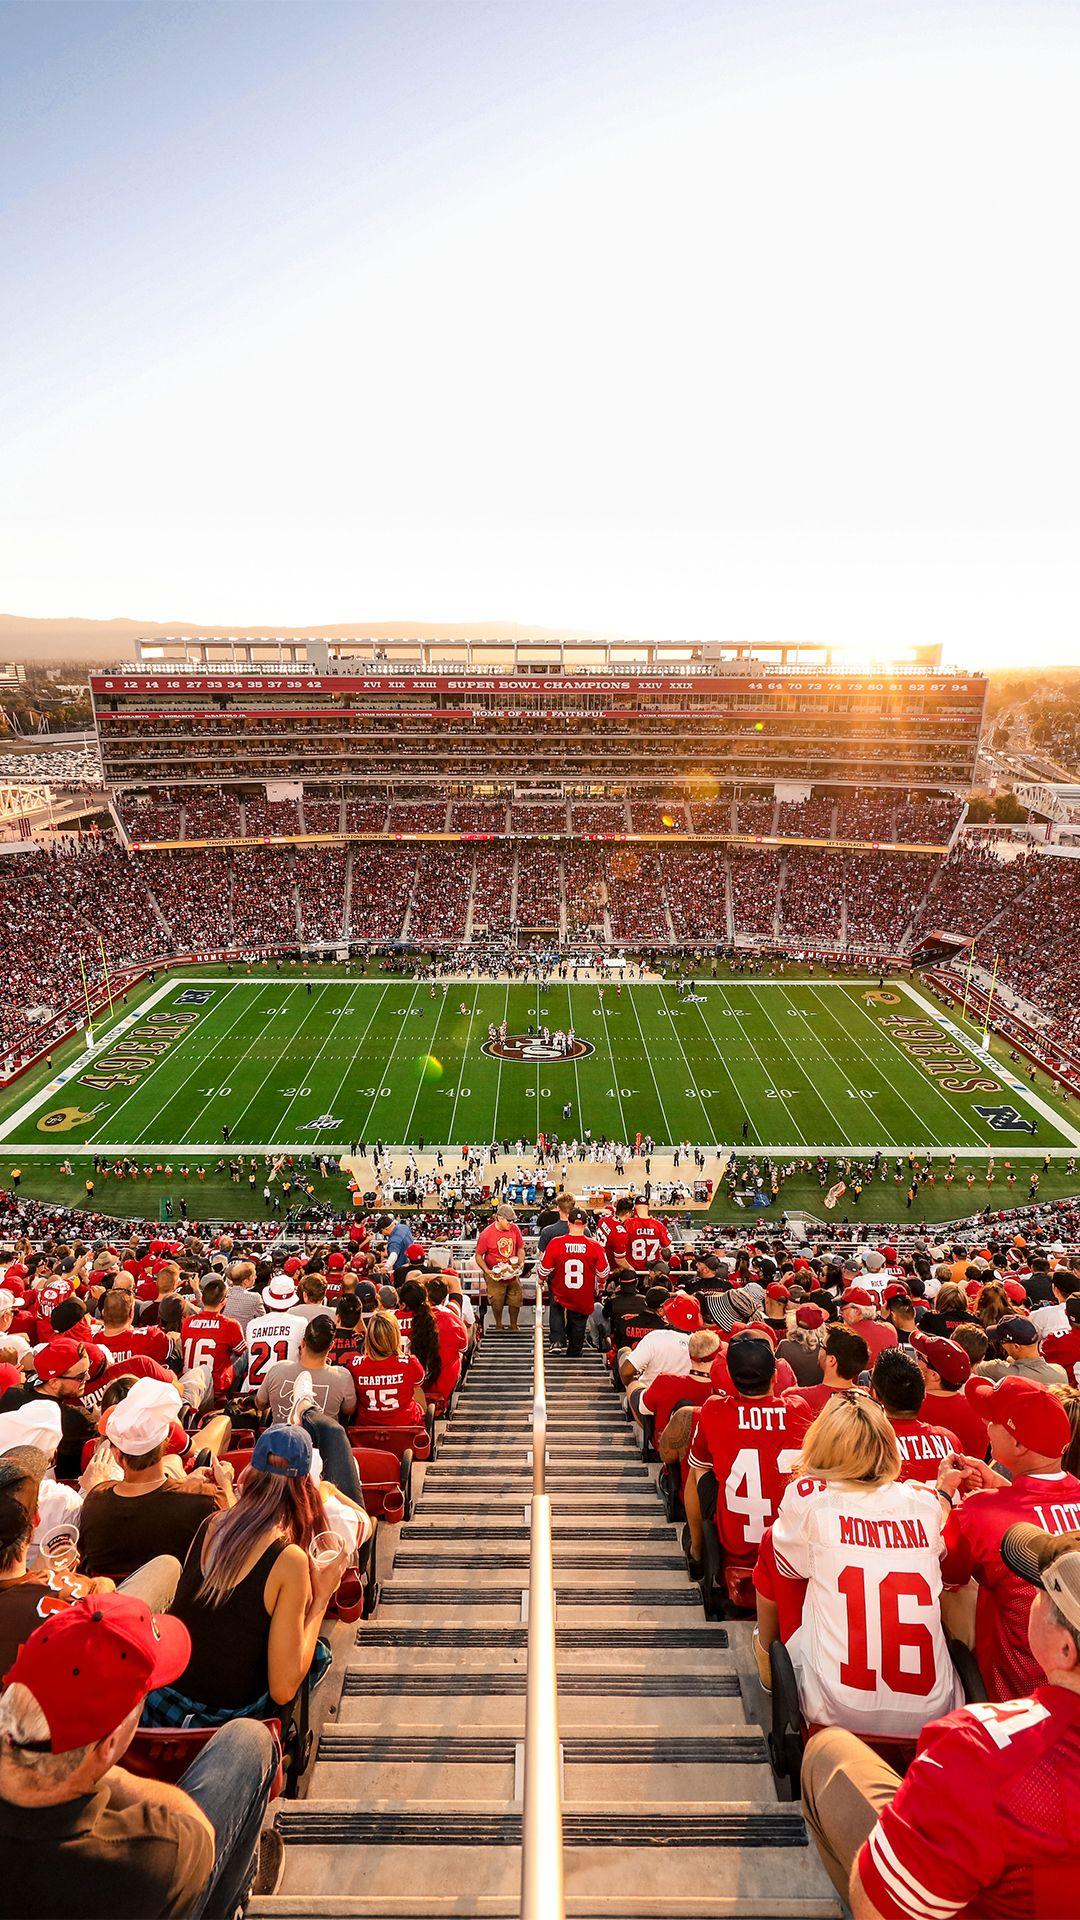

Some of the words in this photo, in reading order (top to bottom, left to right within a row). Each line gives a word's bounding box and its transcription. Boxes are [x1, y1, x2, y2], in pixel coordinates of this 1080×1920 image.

[448, 681, 495, 689] SUPER
[499, 681, 540, 689] BOWL
[197, 953, 223, 962] HOME
[76, 1012, 200, 1090] 49ERS
[877, 1014, 1004, 1093] 49ERS
[976, 1052, 1005, 1071] CATCH
[203, 1087, 232, 1097] 10
[283, 1087, 312, 1097] 20
[363, 1087, 392, 1097] 30
[443, 1088, 472, 1097] 40
[525, 1088, 552, 1098] 50
[605, 1088, 632, 1098] 40
[685, 1088, 712, 1098] 30
[765, 1088, 793, 1098] 20
[846, 1088, 872, 1098] 10
[636, 1228, 655, 1236] CLARK
[565, 1243, 587, 1254] YOUNG
[631, 1239, 660, 1261] 87
[564, 1259, 584, 1289] 8
[188, 1319, 220, 1329] MONTANA
[252, 1325, 290, 1339] SANDERS
[182, 1338, 217, 1374] 16
[249, 1340, 288, 1385] 21
[358, 1373, 404, 1386] CRABTREE
[366, 1388, 400, 1411] 15
[738, 1406, 787, 1431] LOTT
[896, 1434, 954, 1460] NTANA
[839, 1515, 929, 1549] MONTANA
[837, 1565, 938, 1697] 16
